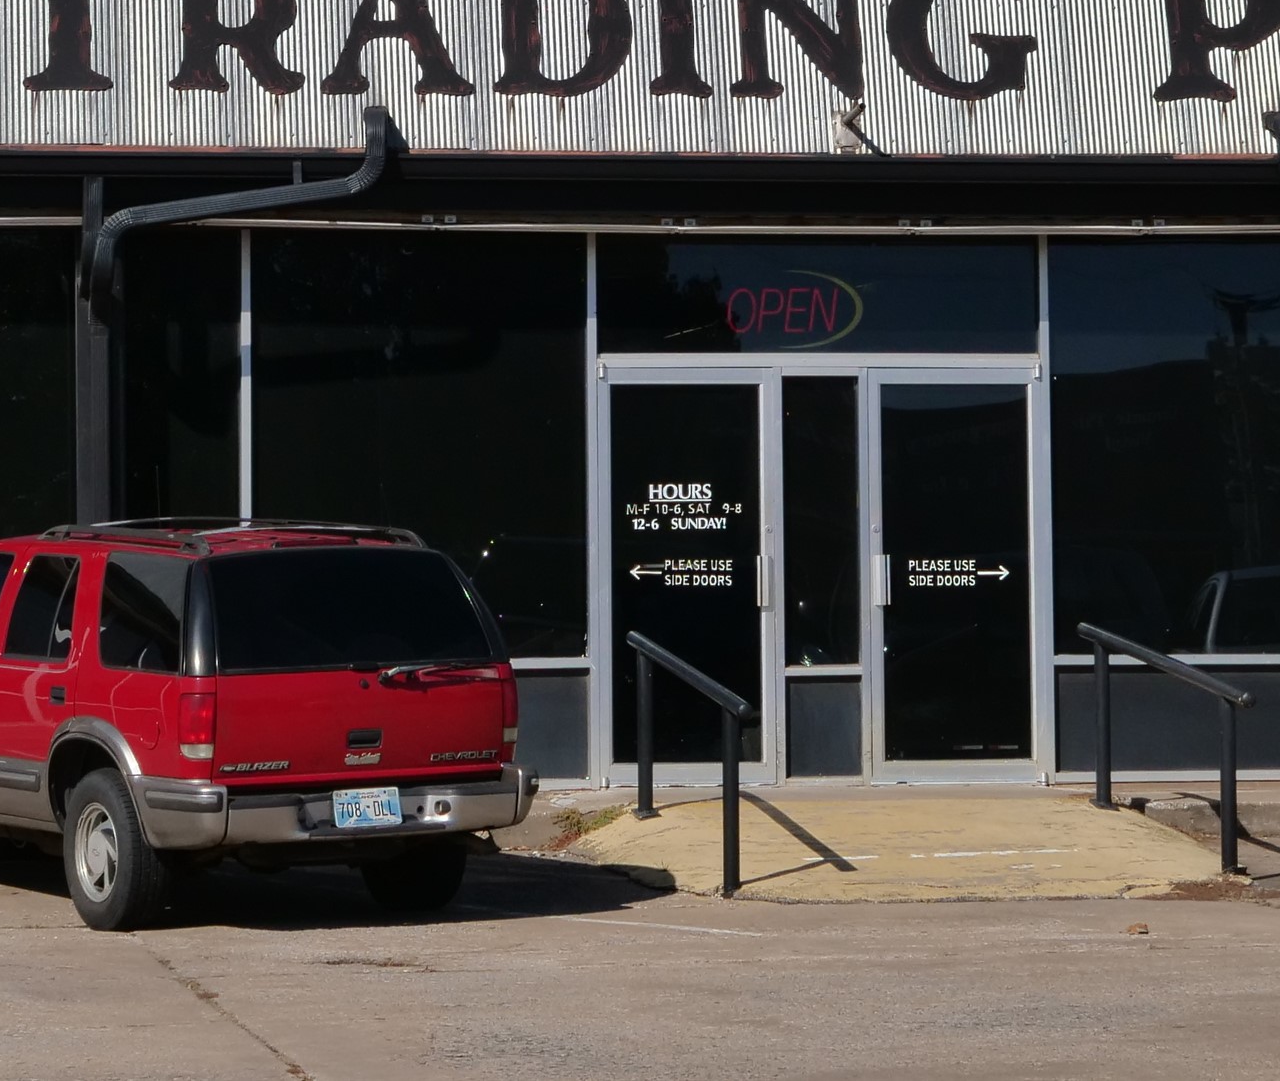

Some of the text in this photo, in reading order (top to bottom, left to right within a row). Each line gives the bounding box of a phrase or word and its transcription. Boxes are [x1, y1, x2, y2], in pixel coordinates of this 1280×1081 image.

[725, 287, 840, 336] OPEN
[648, 483, 713, 501] HOURS
[626, 503, 742, 516] M-F 10-6, SAT 9-8
[632, 517, 727, 530] 12-6 SUNDAY!
[664, 559, 733, 571] PLEASE USE
[908, 560, 976, 572] PLEASE USE
[664, 575, 732, 586] SIDE DOORS
[908, 575, 976, 587] SIDE DOORS
[430, 749, 498, 762] CHEVROLET
[235, 760, 290, 772] BLAZER
